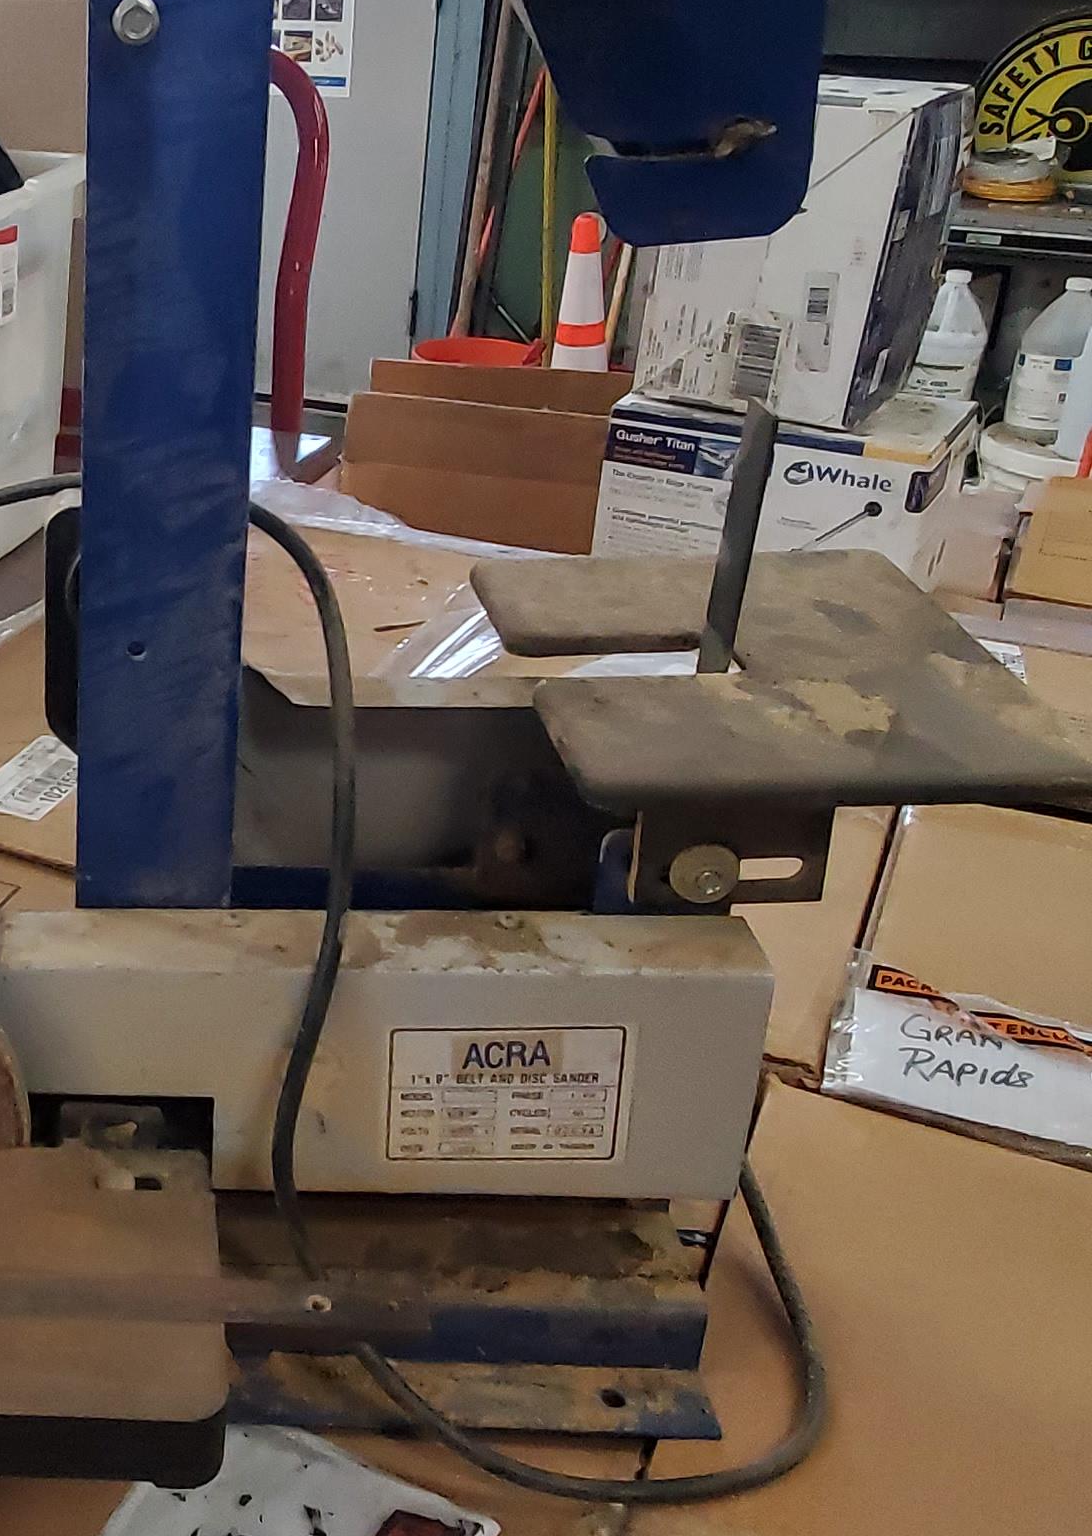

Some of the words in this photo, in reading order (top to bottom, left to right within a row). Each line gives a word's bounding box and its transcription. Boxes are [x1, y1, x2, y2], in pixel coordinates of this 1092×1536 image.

[979, 40, 1061, 136] SAFETY
[616, 429, 660, 446] Gusher
[666, 437, 696, 452] Titan
[815, 464, 892, 492] Whale
[461, 1040, 551, 1070] ACRA
[456, 1073, 484, 1084] BELT
[490, 1072, 514, 1084] AND
[520, 1072, 547, 1084] DISC
[553, 1072, 599, 1083] SANDER
